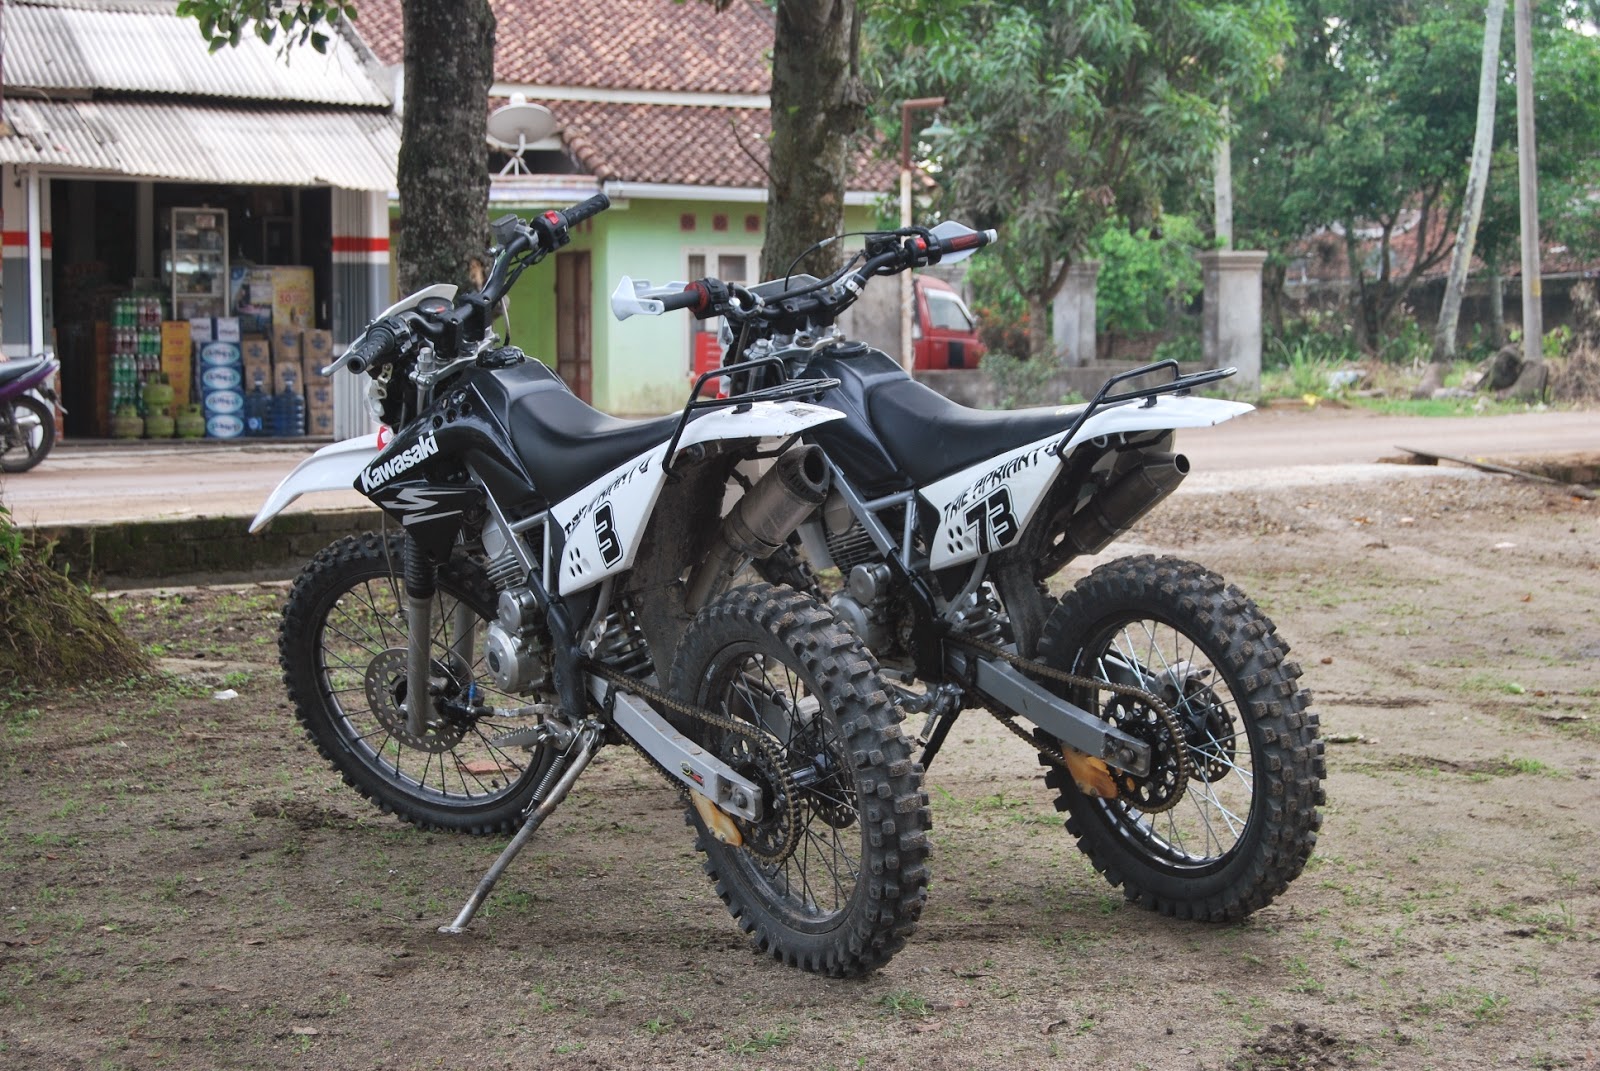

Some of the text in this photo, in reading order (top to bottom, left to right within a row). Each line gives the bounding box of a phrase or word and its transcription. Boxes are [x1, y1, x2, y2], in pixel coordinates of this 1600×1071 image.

[360, 429, 439, 493] Kawasaki
[593, 500, 624, 570] 3
[963, 483, 1021, 556] 73
